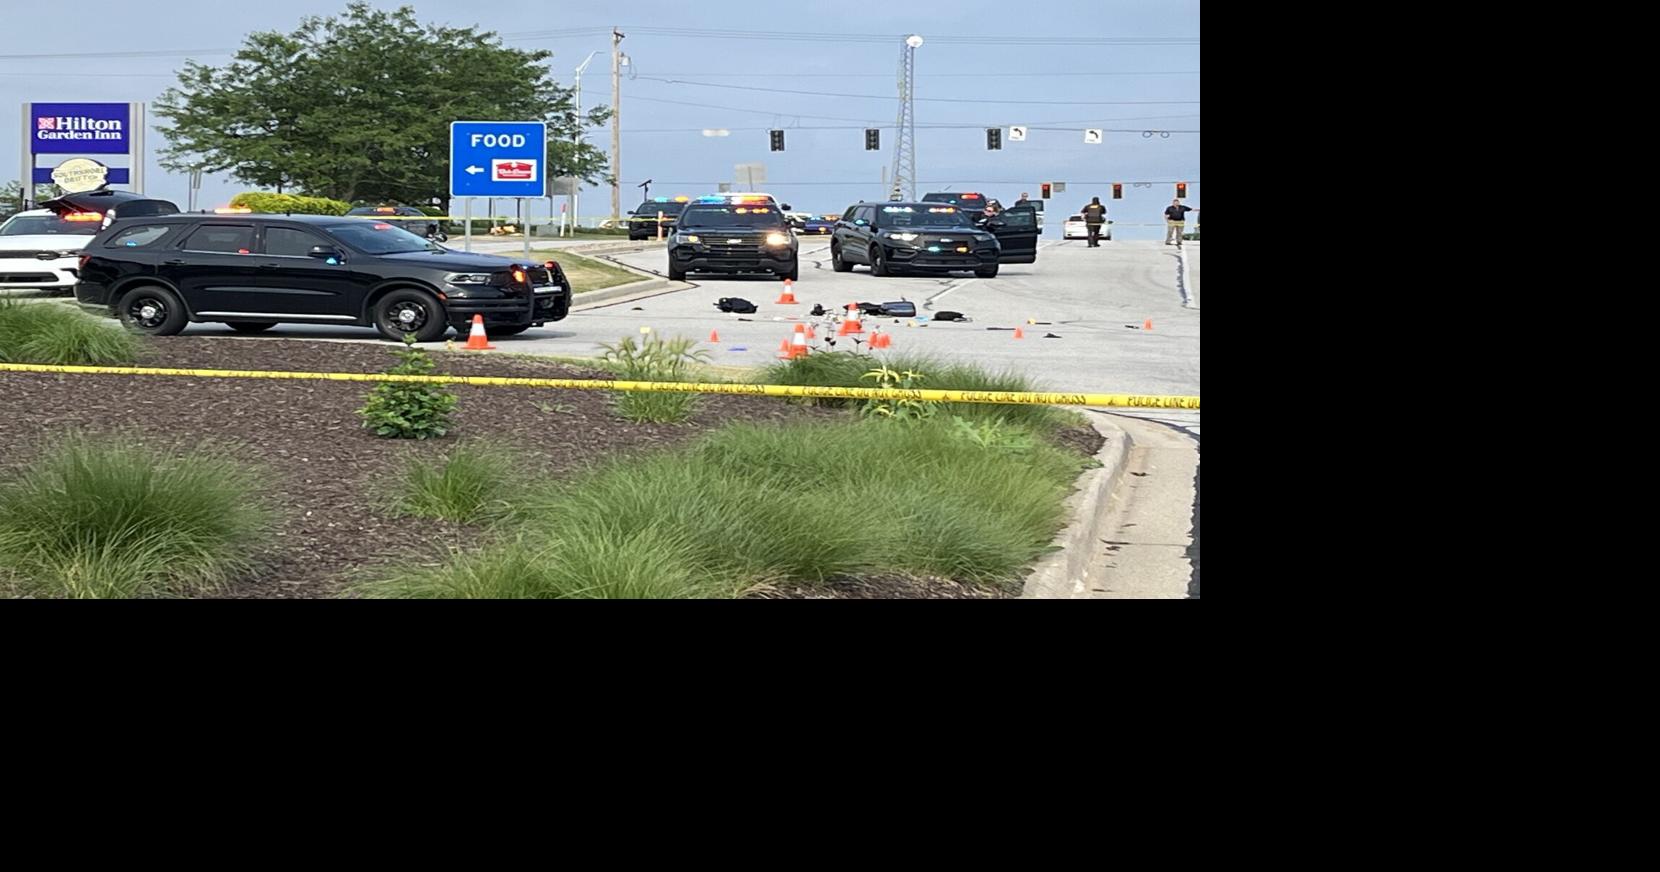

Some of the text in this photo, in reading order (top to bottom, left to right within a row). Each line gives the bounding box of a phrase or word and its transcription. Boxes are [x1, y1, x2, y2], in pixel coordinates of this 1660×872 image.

[56, 116, 122, 130] Hilton
[37, 129, 122, 140] Garden Inn
[471, 133, 526, 148] FOOD
